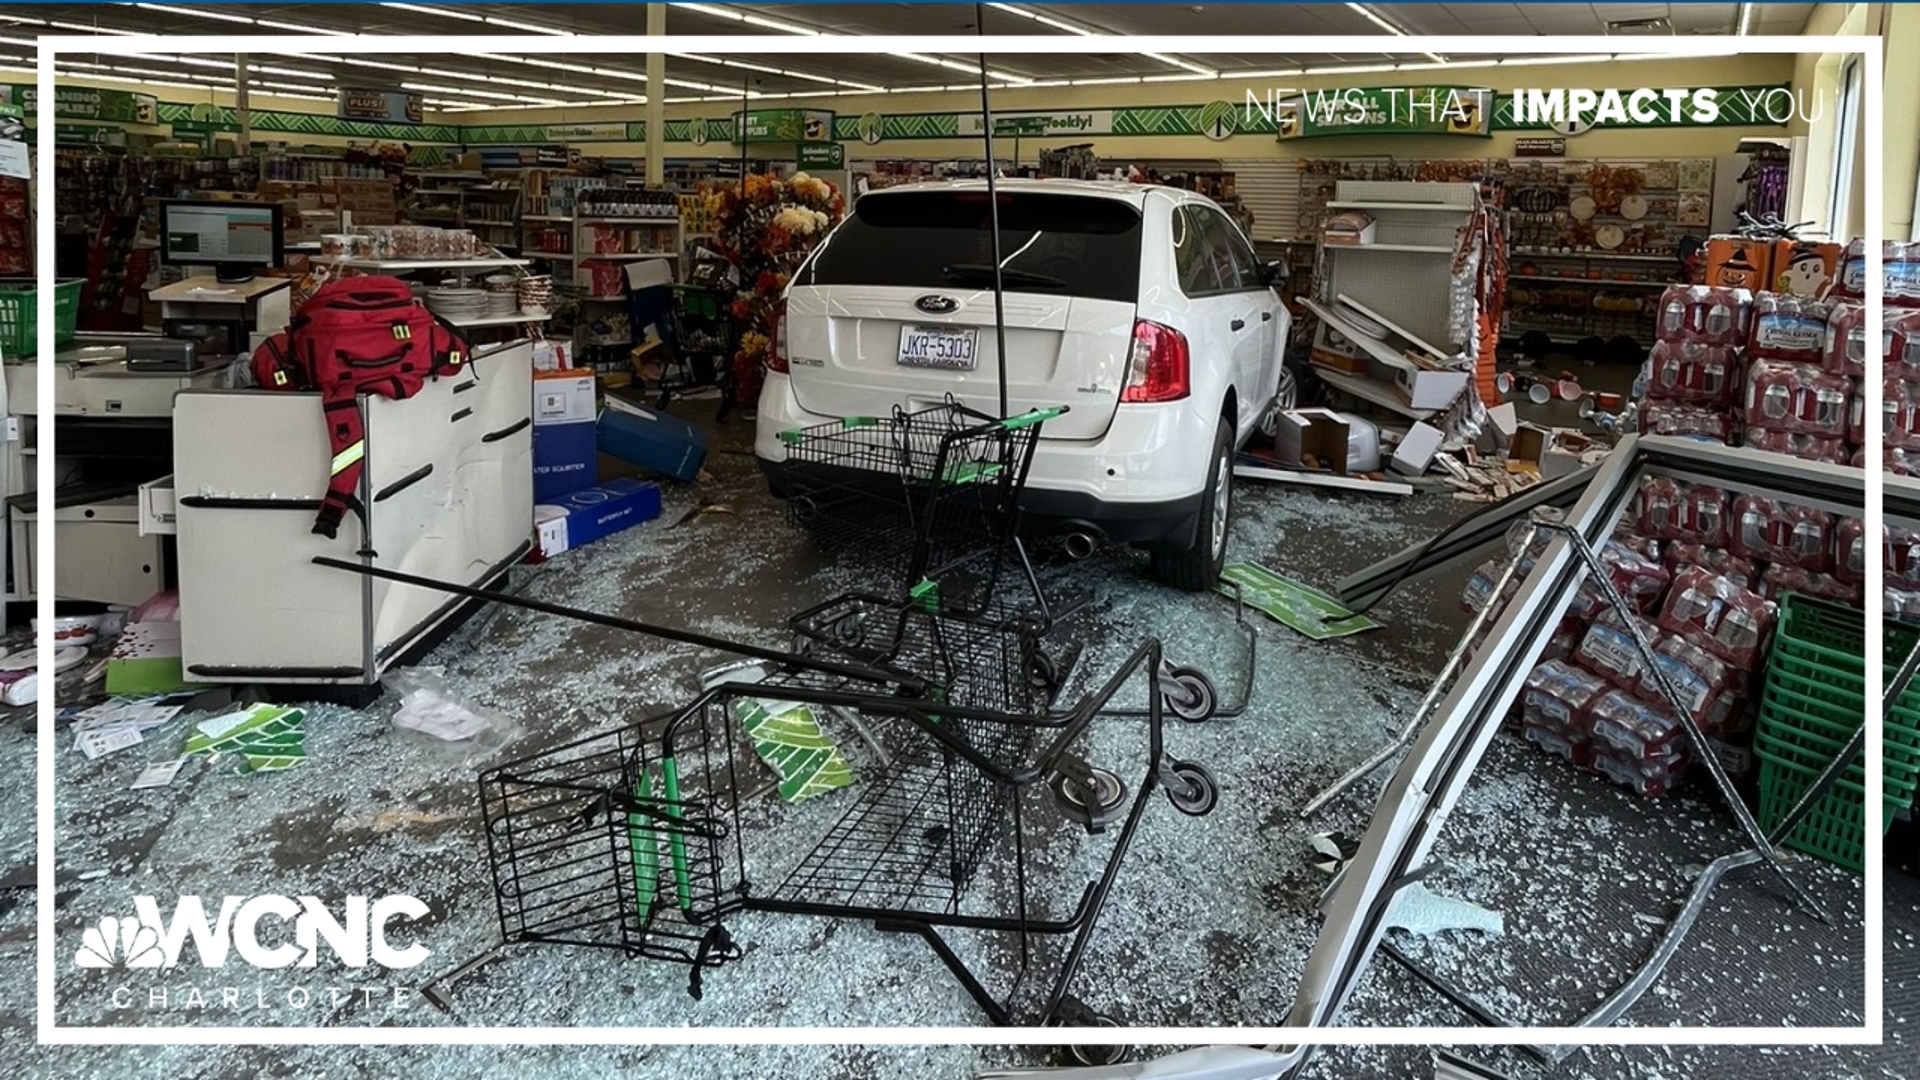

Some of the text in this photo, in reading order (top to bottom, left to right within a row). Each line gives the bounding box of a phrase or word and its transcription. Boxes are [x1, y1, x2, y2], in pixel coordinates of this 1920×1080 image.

[22, 89, 100, 103] CLANING
[23, 101, 96, 114] SUPLIES
[1317, 97, 1380, 113] FOR ALL
[740, 116, 758, 125] PRTY
[1316, 111, 1388, 126] SEASONS
[740, 126, 768, 136] SPPLIES
[902, 335, 972, 358] JKR-5303
